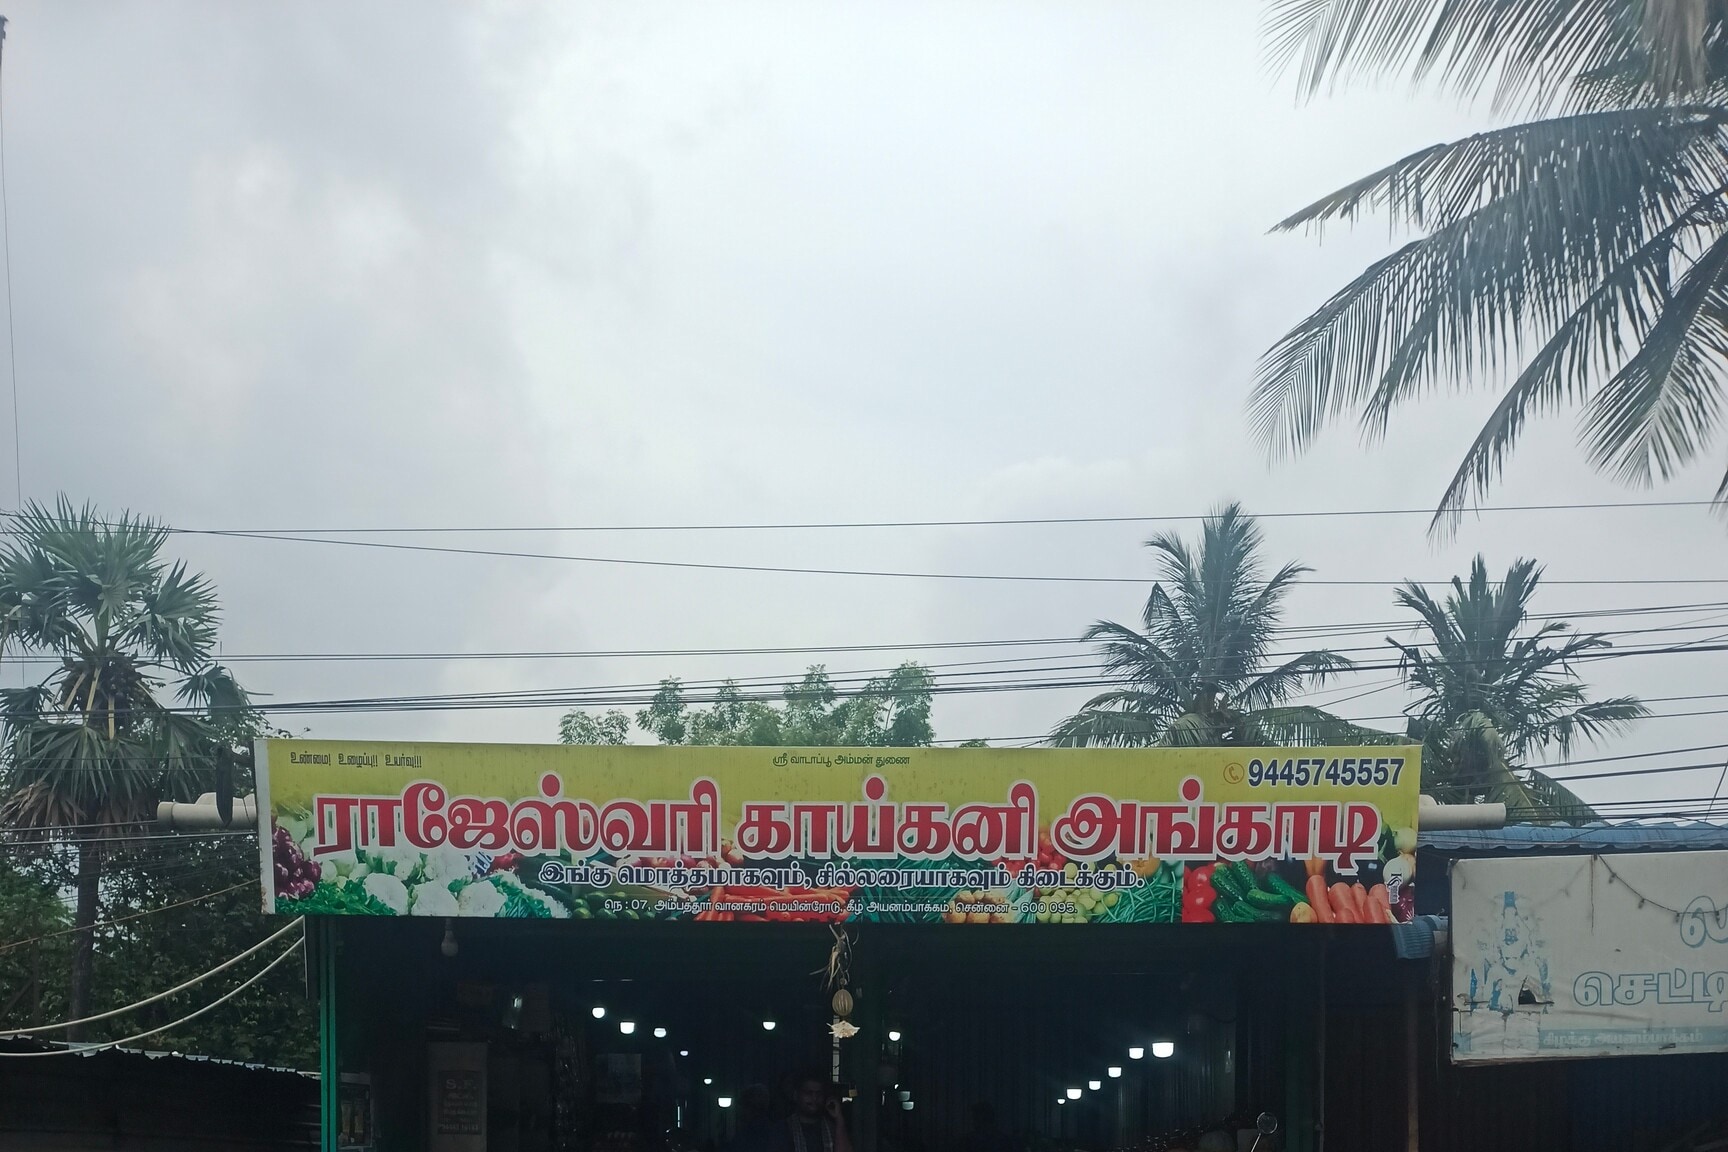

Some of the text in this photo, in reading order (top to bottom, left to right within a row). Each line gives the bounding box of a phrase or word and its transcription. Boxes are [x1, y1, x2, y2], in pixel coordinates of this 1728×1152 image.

[834, 753, 874, 765] அம்மன்
[875, 755, 910, 768] துணை
[1248, 758, 1405, 787] 9445745557
[313, 772, 1379, 872] ராஜேஸ்வரி காய்கனி அங்காடி
[540, 859, 1145, 890] இங்கு மொத்தமாகவும், சில்லரையாகவும் கிடைக்கும்.
[654, 899, 712, 914] அம்பத்தூர்
[714, 899, 767, 912] வானகரம்
[955, 901, 1008, 914] சென்னை
[1020, 902, 1046, 914] 600
